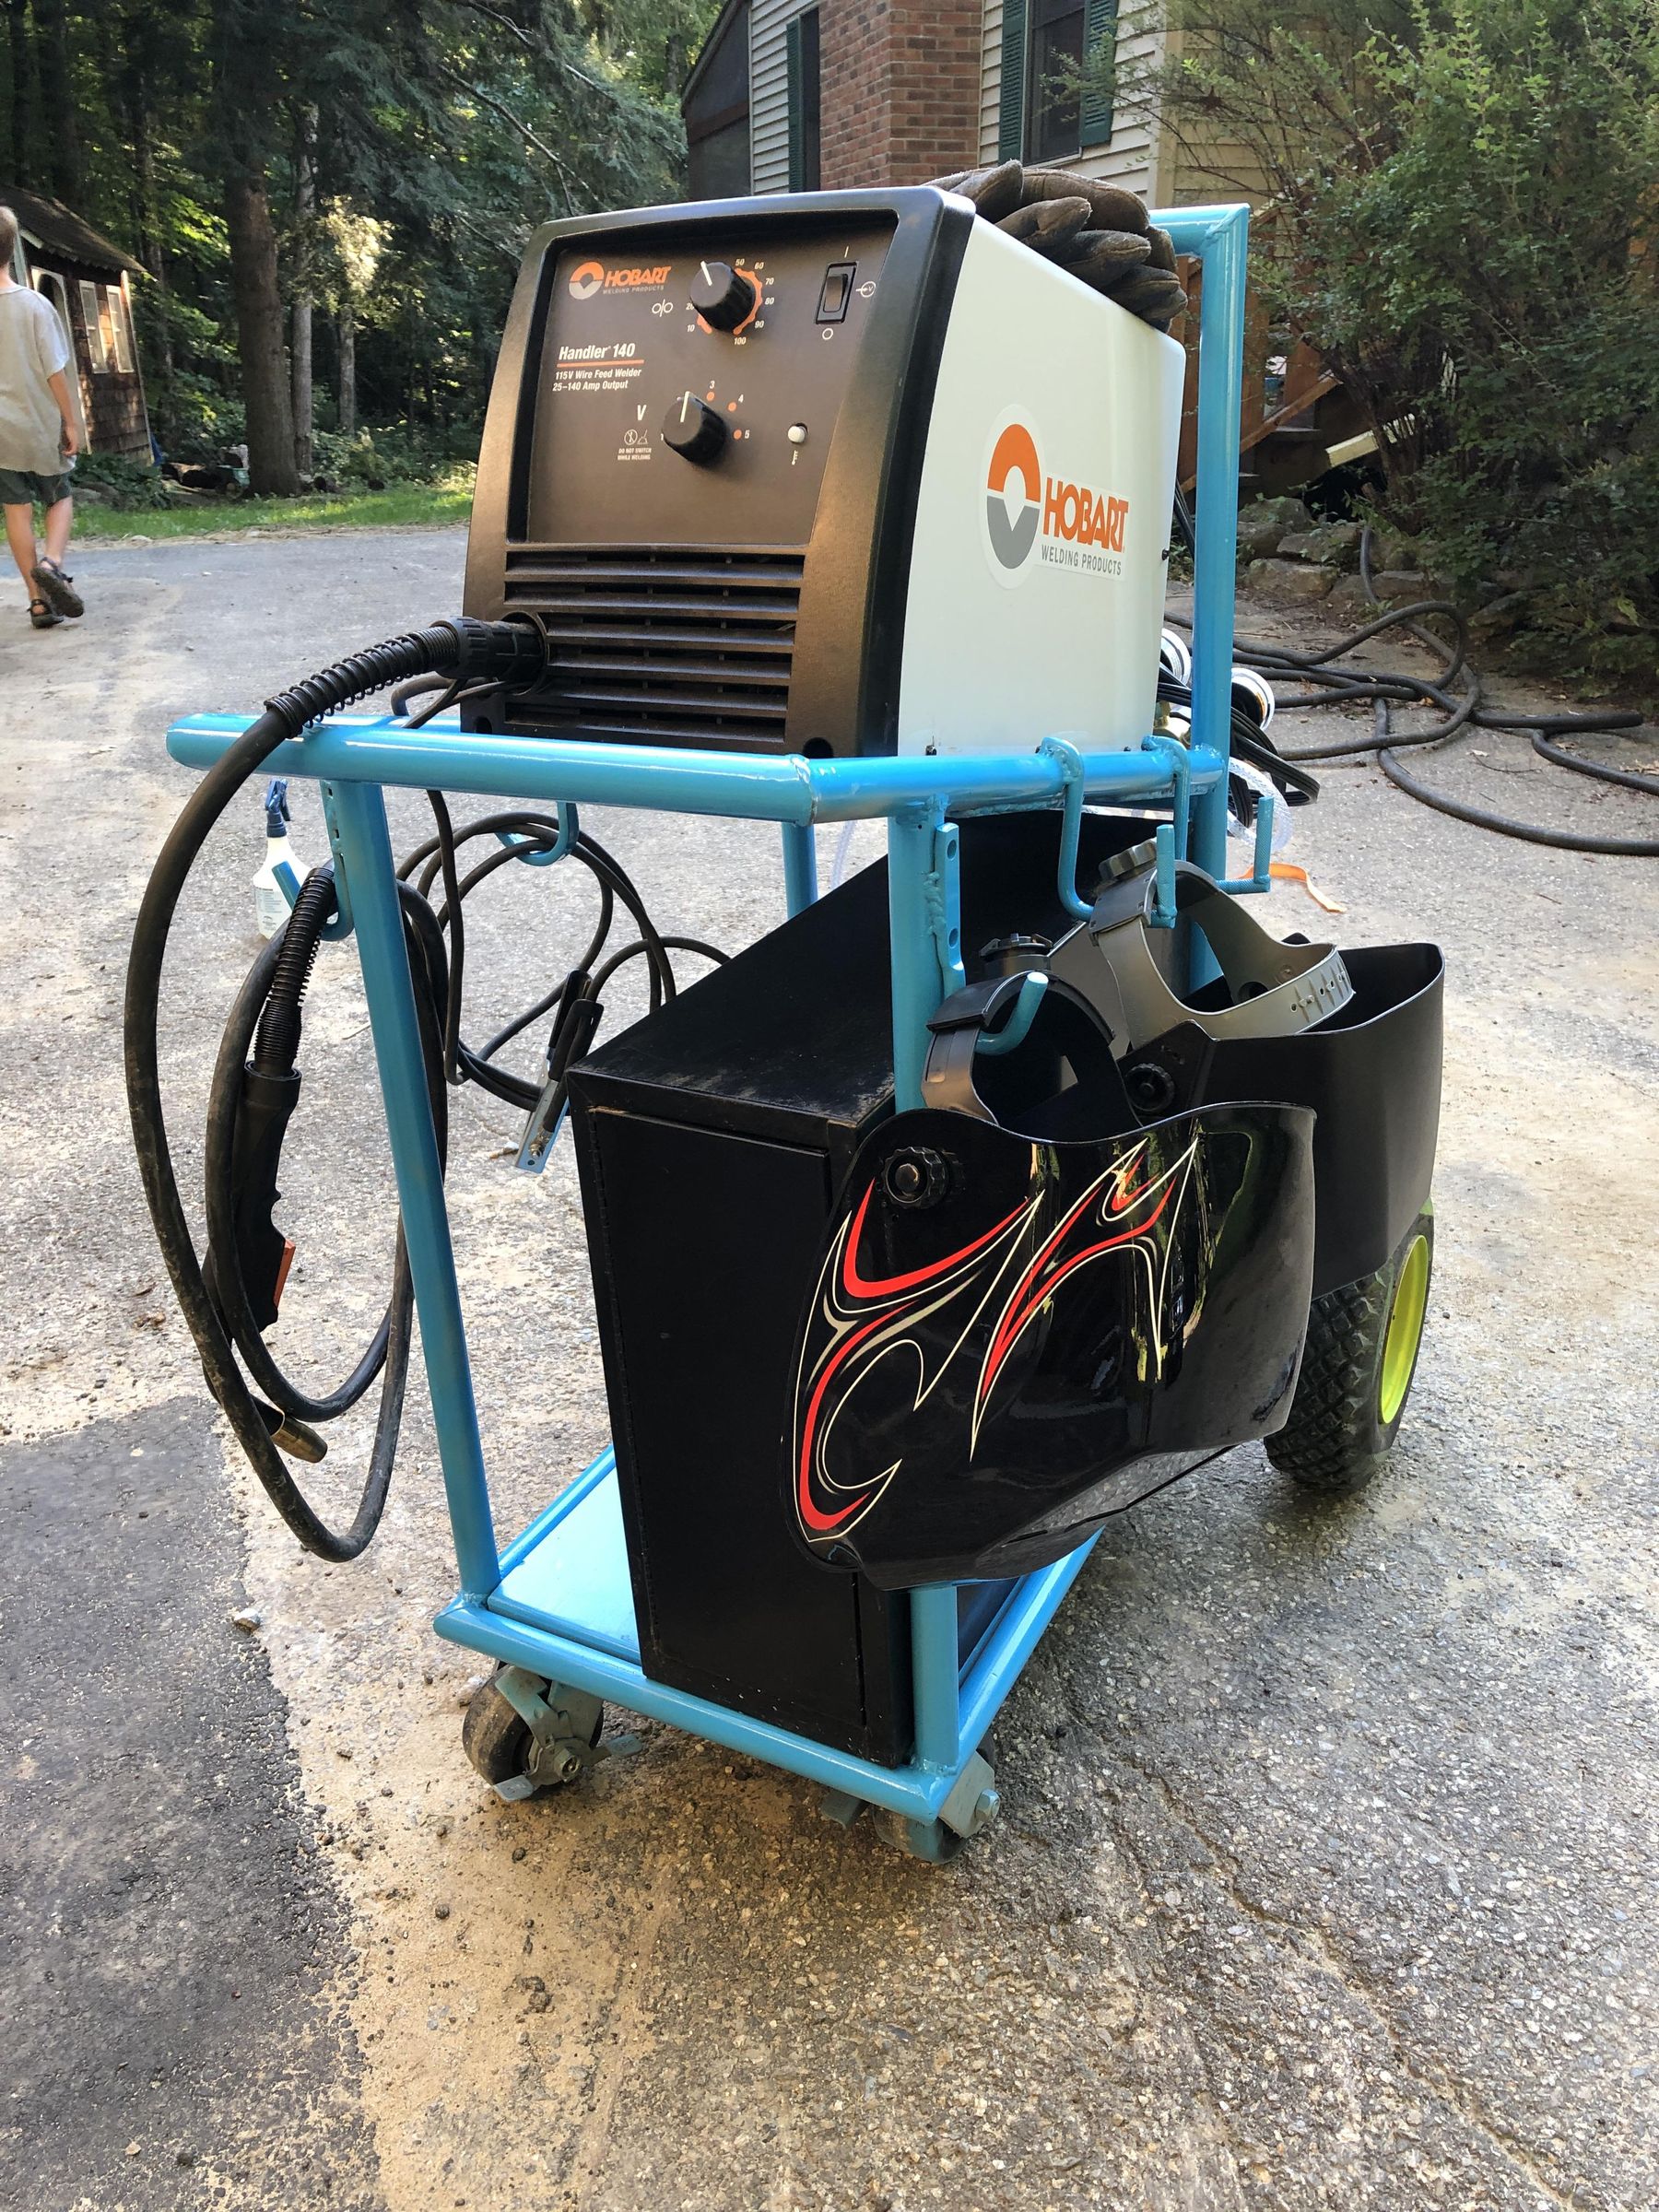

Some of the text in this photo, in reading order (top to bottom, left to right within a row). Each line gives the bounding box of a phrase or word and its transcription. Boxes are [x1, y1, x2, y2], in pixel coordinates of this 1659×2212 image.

[605, 265, 672, 288] HOBART
[559, 343, 636, 360] Handler 140
[556, 368, 641, 380] 115V Wire Feed Welder
[582, 381, 600, 391] Amp
[602, 380, 629, 390] Output
[709, 381, 715, 389] 3
[738, 394, 744, 403] 4
[637, 405, 647, 420] V
[745, 429, 750, 439] 5
[1043, 477, 1129, 553] HOBART
[1041, 545, 1122, 575] WELDING PRODUCTS
